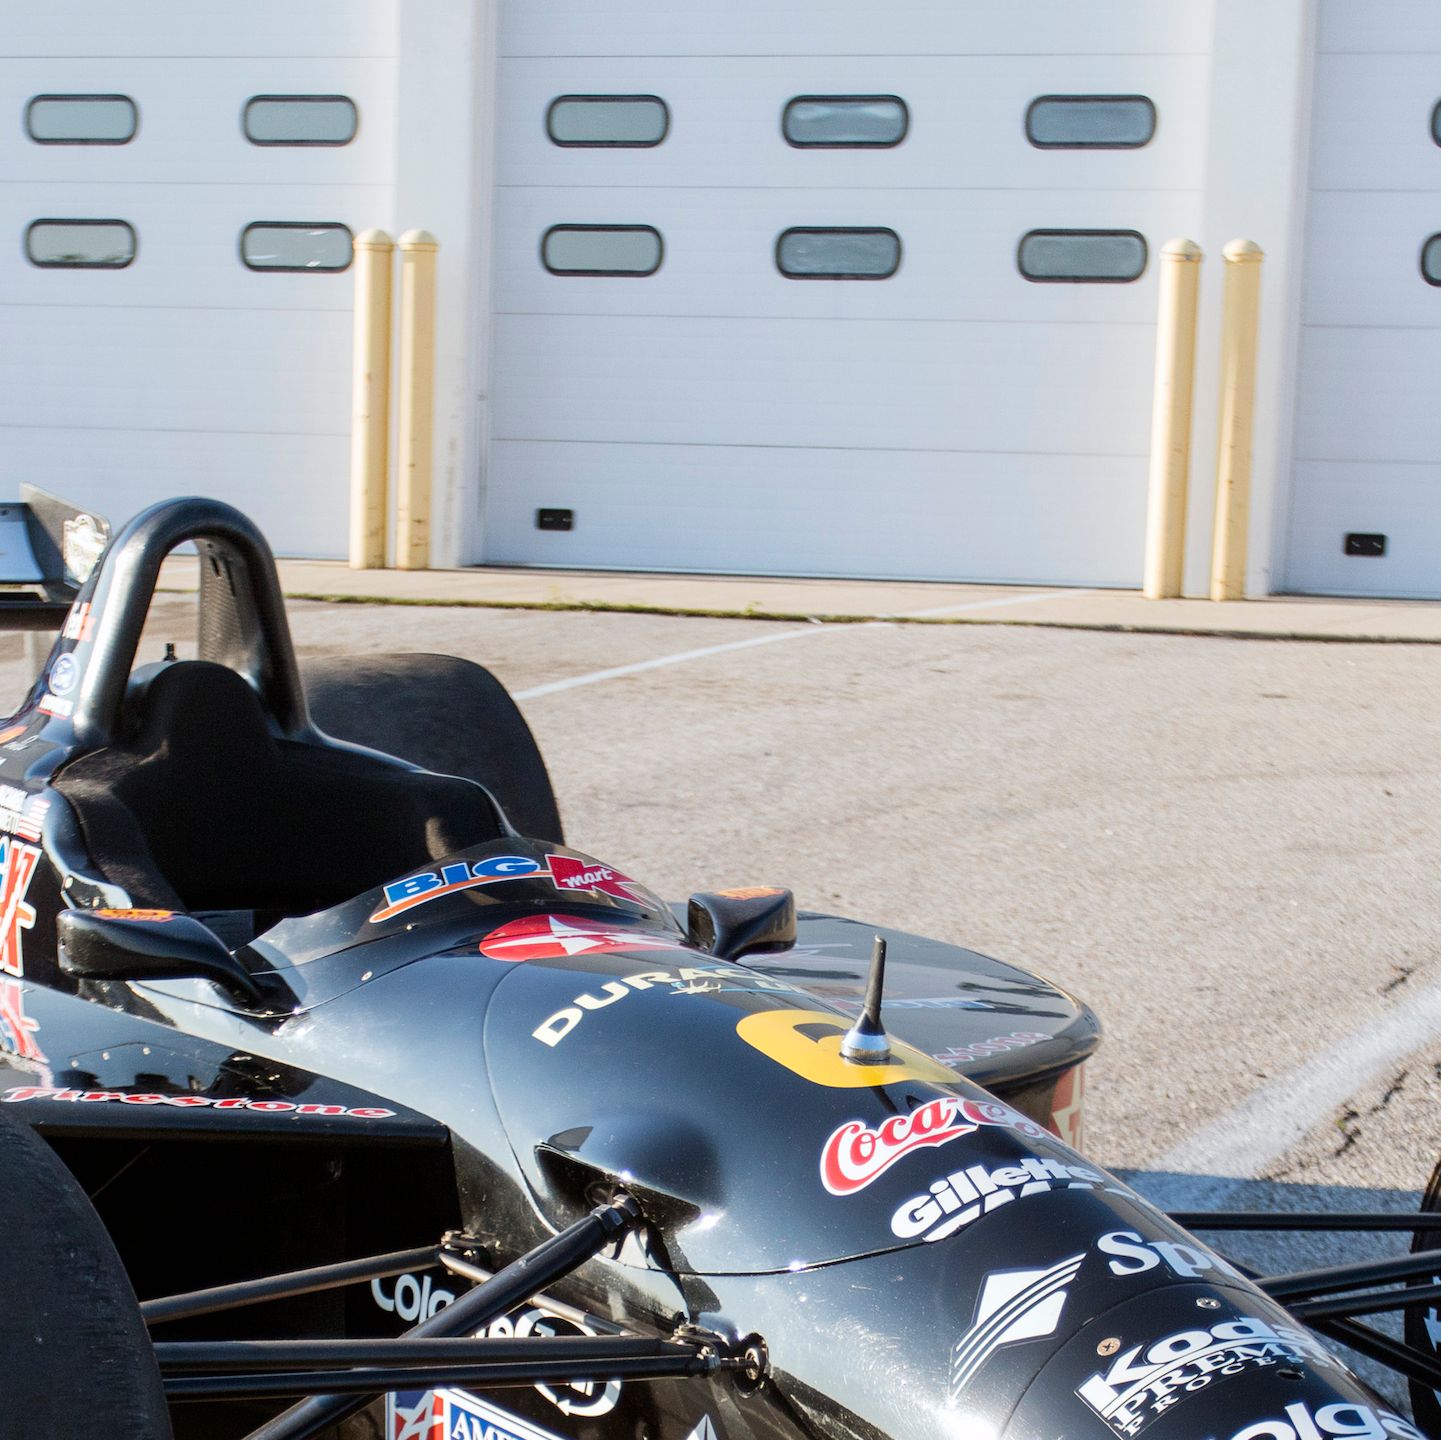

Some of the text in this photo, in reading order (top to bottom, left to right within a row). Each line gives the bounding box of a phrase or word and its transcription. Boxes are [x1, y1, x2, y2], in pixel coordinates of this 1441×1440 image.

[383, 855, 542, 909] BIG
[564, 866, 616, 890] mart
[1, 1084, 397, 1120] Firestone
[890, 1157, 1105, 1239] Gillette
